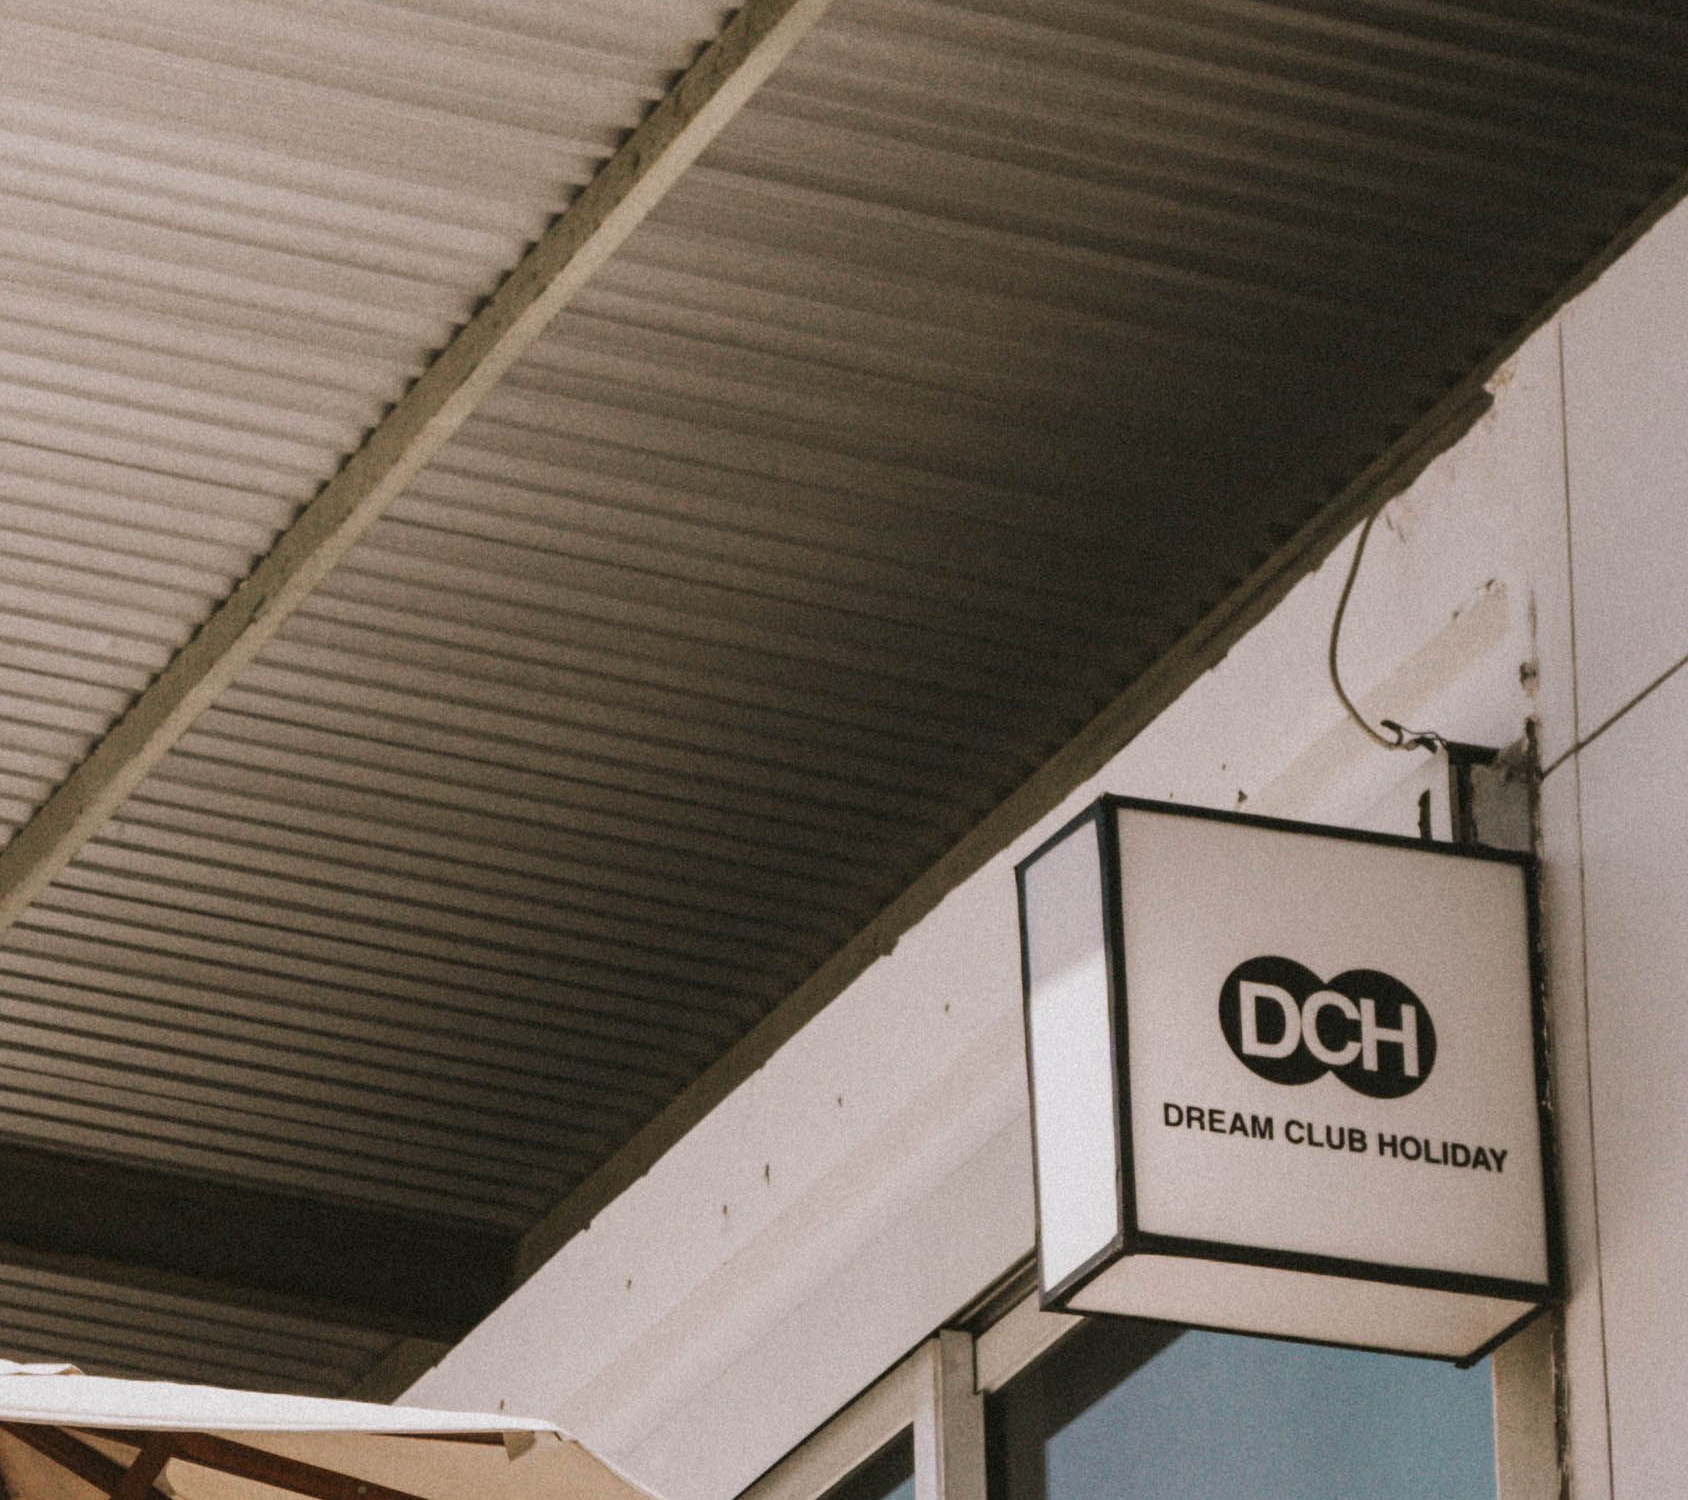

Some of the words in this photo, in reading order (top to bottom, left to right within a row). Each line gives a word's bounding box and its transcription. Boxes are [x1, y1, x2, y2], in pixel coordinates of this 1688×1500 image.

[1238, 980, 1419, 1078] DCH
[1163, 1102, 1273, 1141] DREAM
[1285, 1119, 1367, 1153] CLUB
[1378, 1133, 1508, 1173] HOLIDAY
